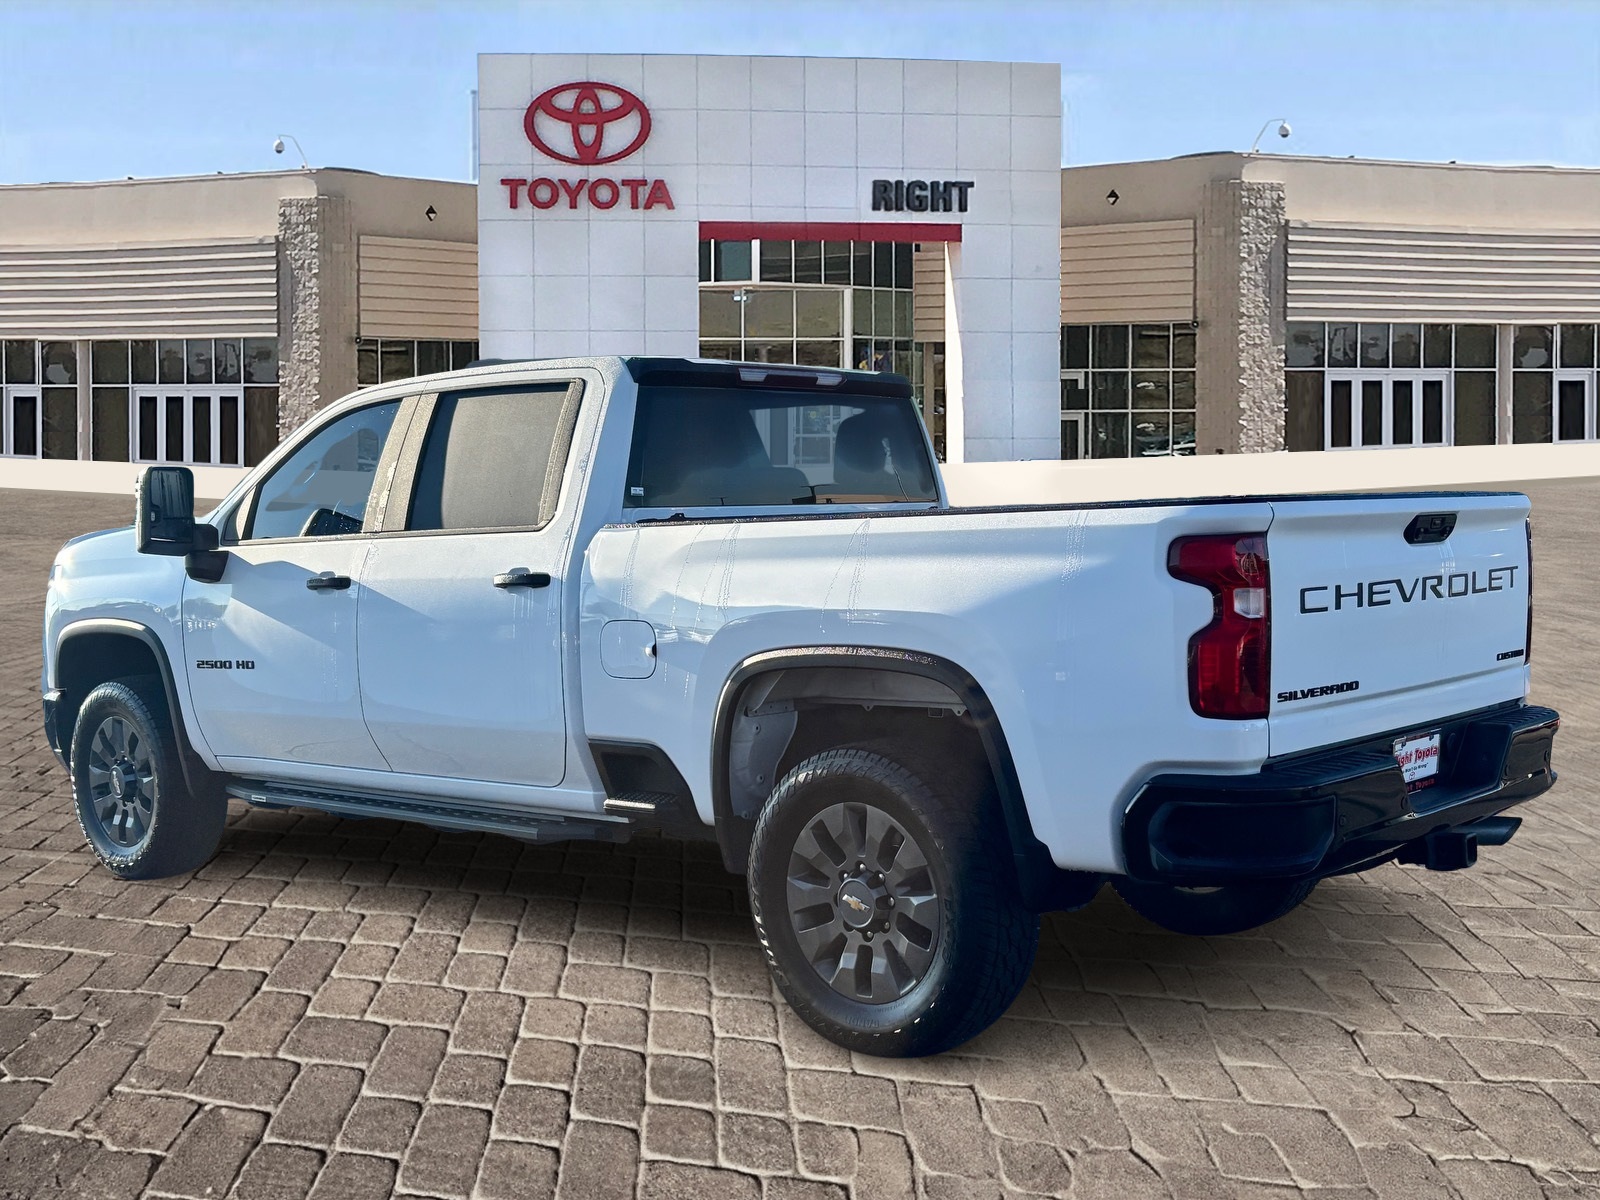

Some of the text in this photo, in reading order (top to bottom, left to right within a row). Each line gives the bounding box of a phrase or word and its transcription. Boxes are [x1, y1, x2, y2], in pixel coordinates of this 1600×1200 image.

[500, 178, 675, 211] TOYOTA
[871, 179, 975, 213] RIGHT
[1300, 566, 1518, 614] CHEVROLET
[196, 660, 255, 669] 2500 HD
[1277, 680, 1359, 703] SILVERADO
[1414, 744, 1438, 764] Toyota
